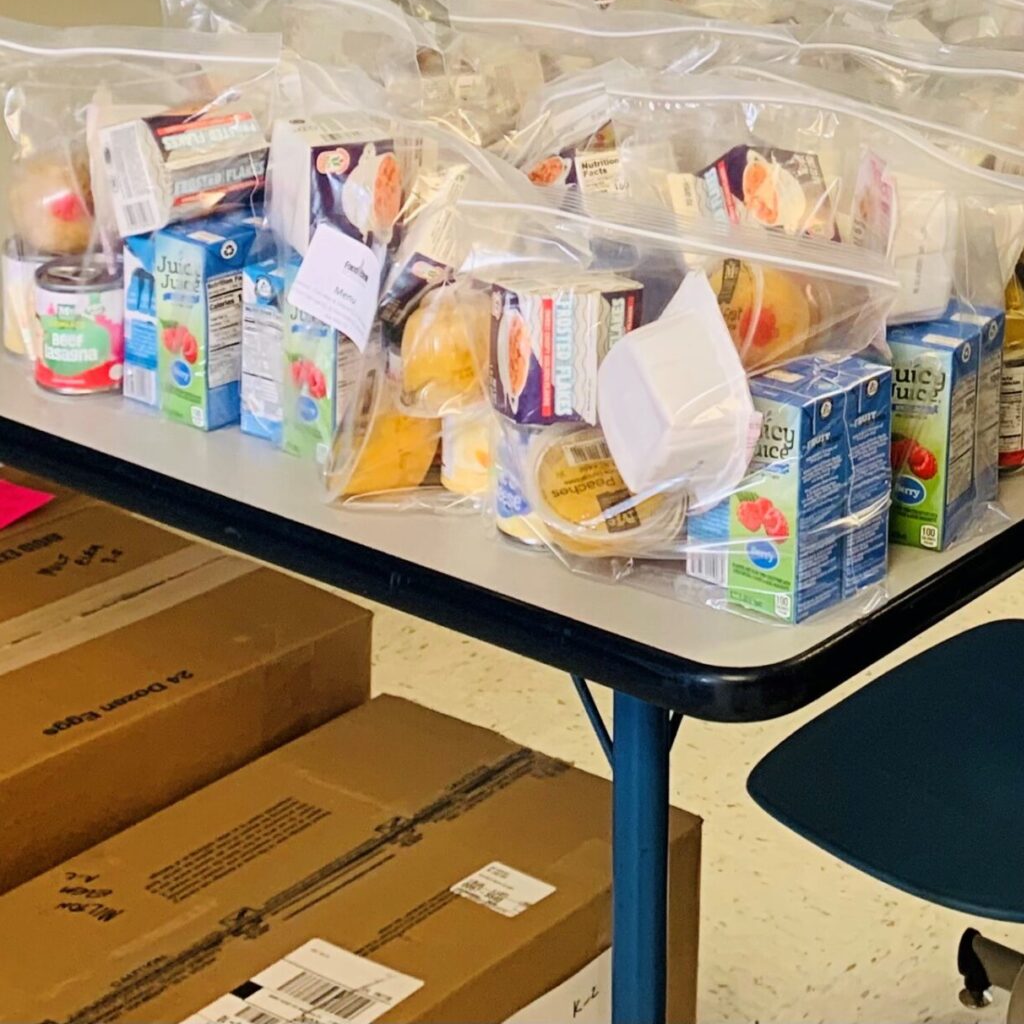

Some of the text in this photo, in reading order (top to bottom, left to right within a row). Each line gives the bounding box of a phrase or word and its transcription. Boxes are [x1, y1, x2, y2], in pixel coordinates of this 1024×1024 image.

[582, 158, 619, 169] Nutrition
[334, 286, 358, 305] Menu
[51, 332, 83, 347] Beef
[551, 475, 616, 498] Peaches
[922, 526, 936, 538] 100
[42, 669, 194, 736] 24 Dozen Eggs
